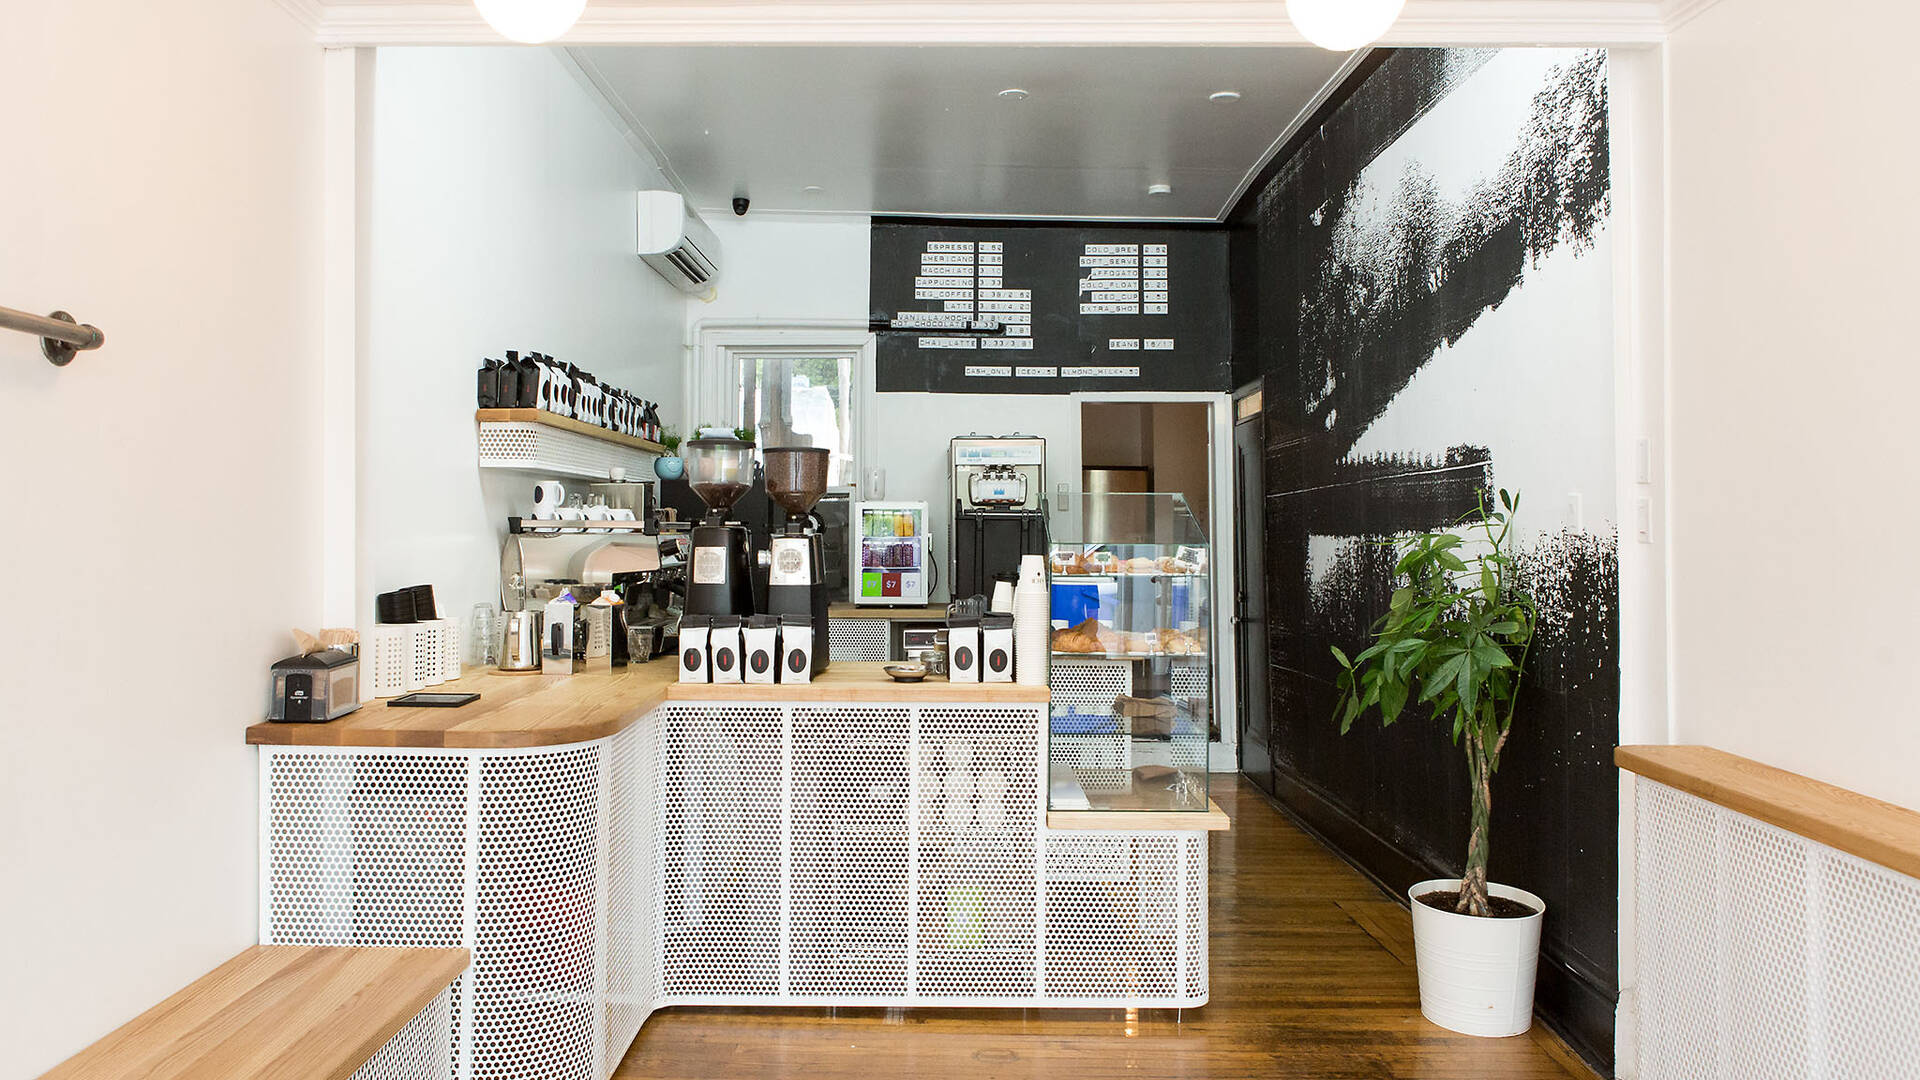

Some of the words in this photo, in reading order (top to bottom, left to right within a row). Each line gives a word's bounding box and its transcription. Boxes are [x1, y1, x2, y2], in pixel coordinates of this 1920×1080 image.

[922, 255, 974, 263] AMERICANO
[922, 267, 974, 275] MACCHIATO
[1110, 341, 1138, 349] BEANS
[866, 580, 877, 588] $7
[886, 580, 897, 589] $7
[905, 580, 916, 589] $7
